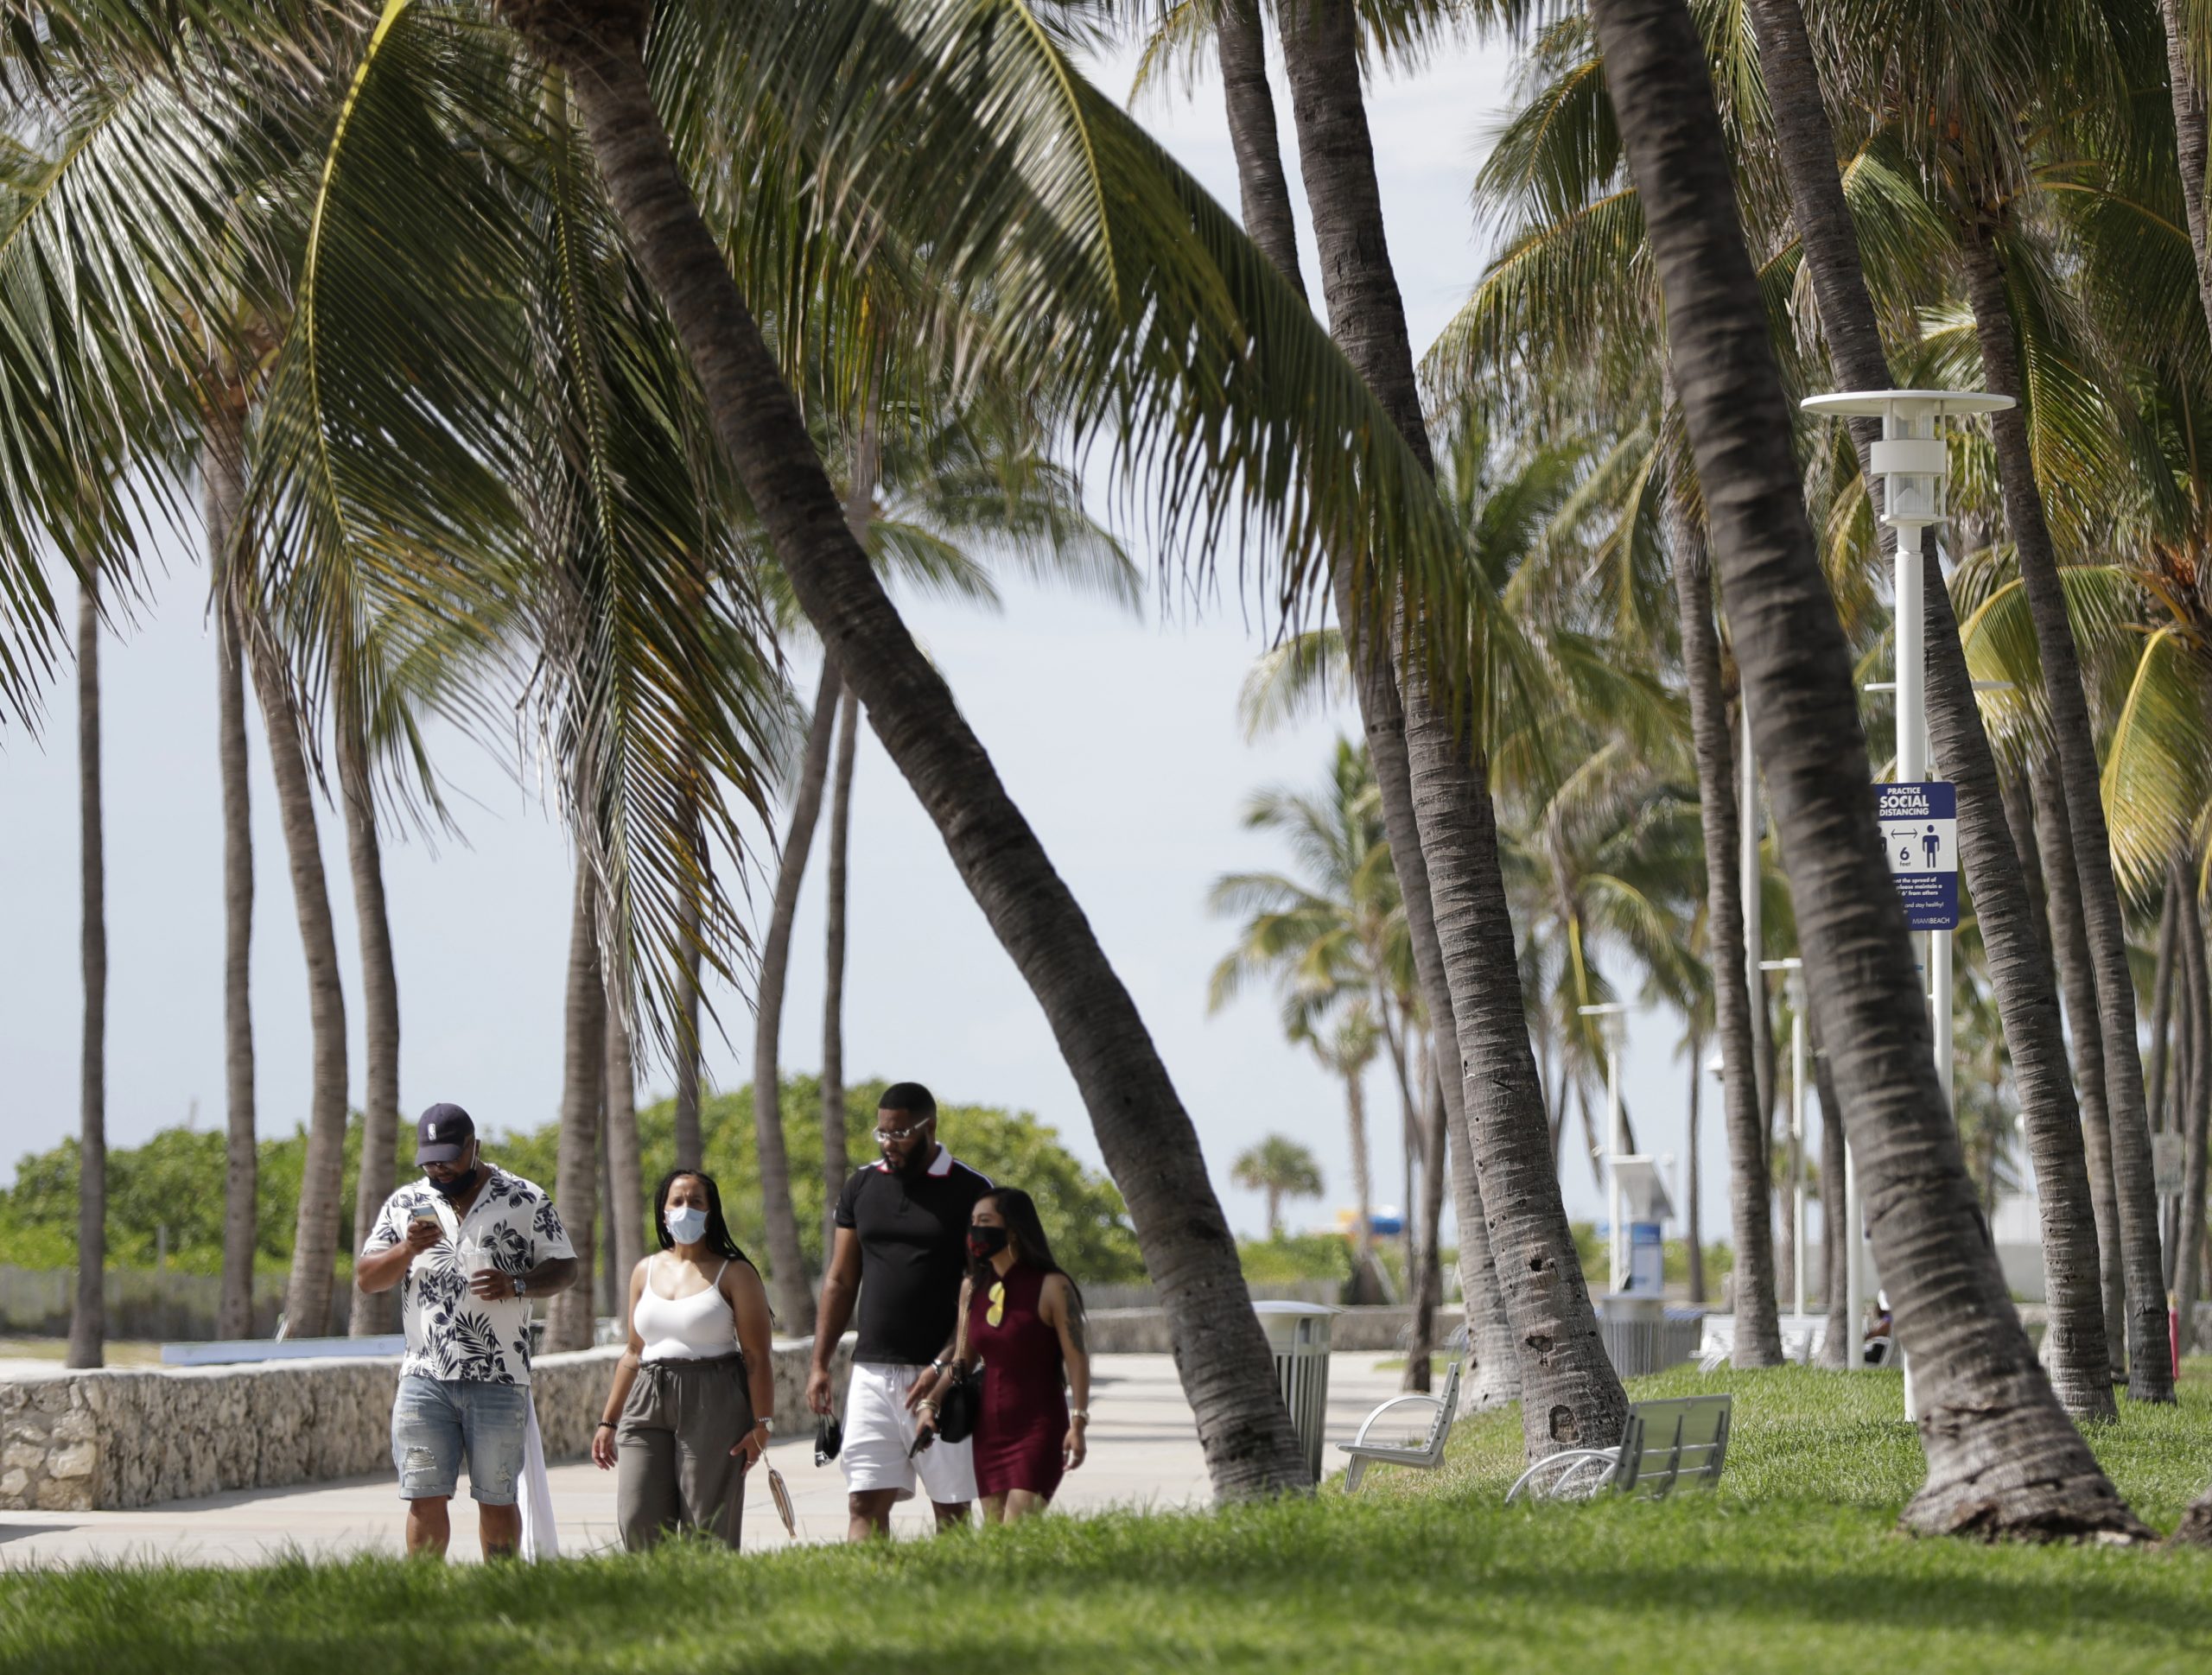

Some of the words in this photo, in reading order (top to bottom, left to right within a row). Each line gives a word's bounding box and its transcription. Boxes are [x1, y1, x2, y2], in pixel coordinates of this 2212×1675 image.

[1879, 795, 1929, 809] SOCIAL
[1879, 808, 1929, 816] DISTANCING
[1900, 847, 1910, 860] 6
